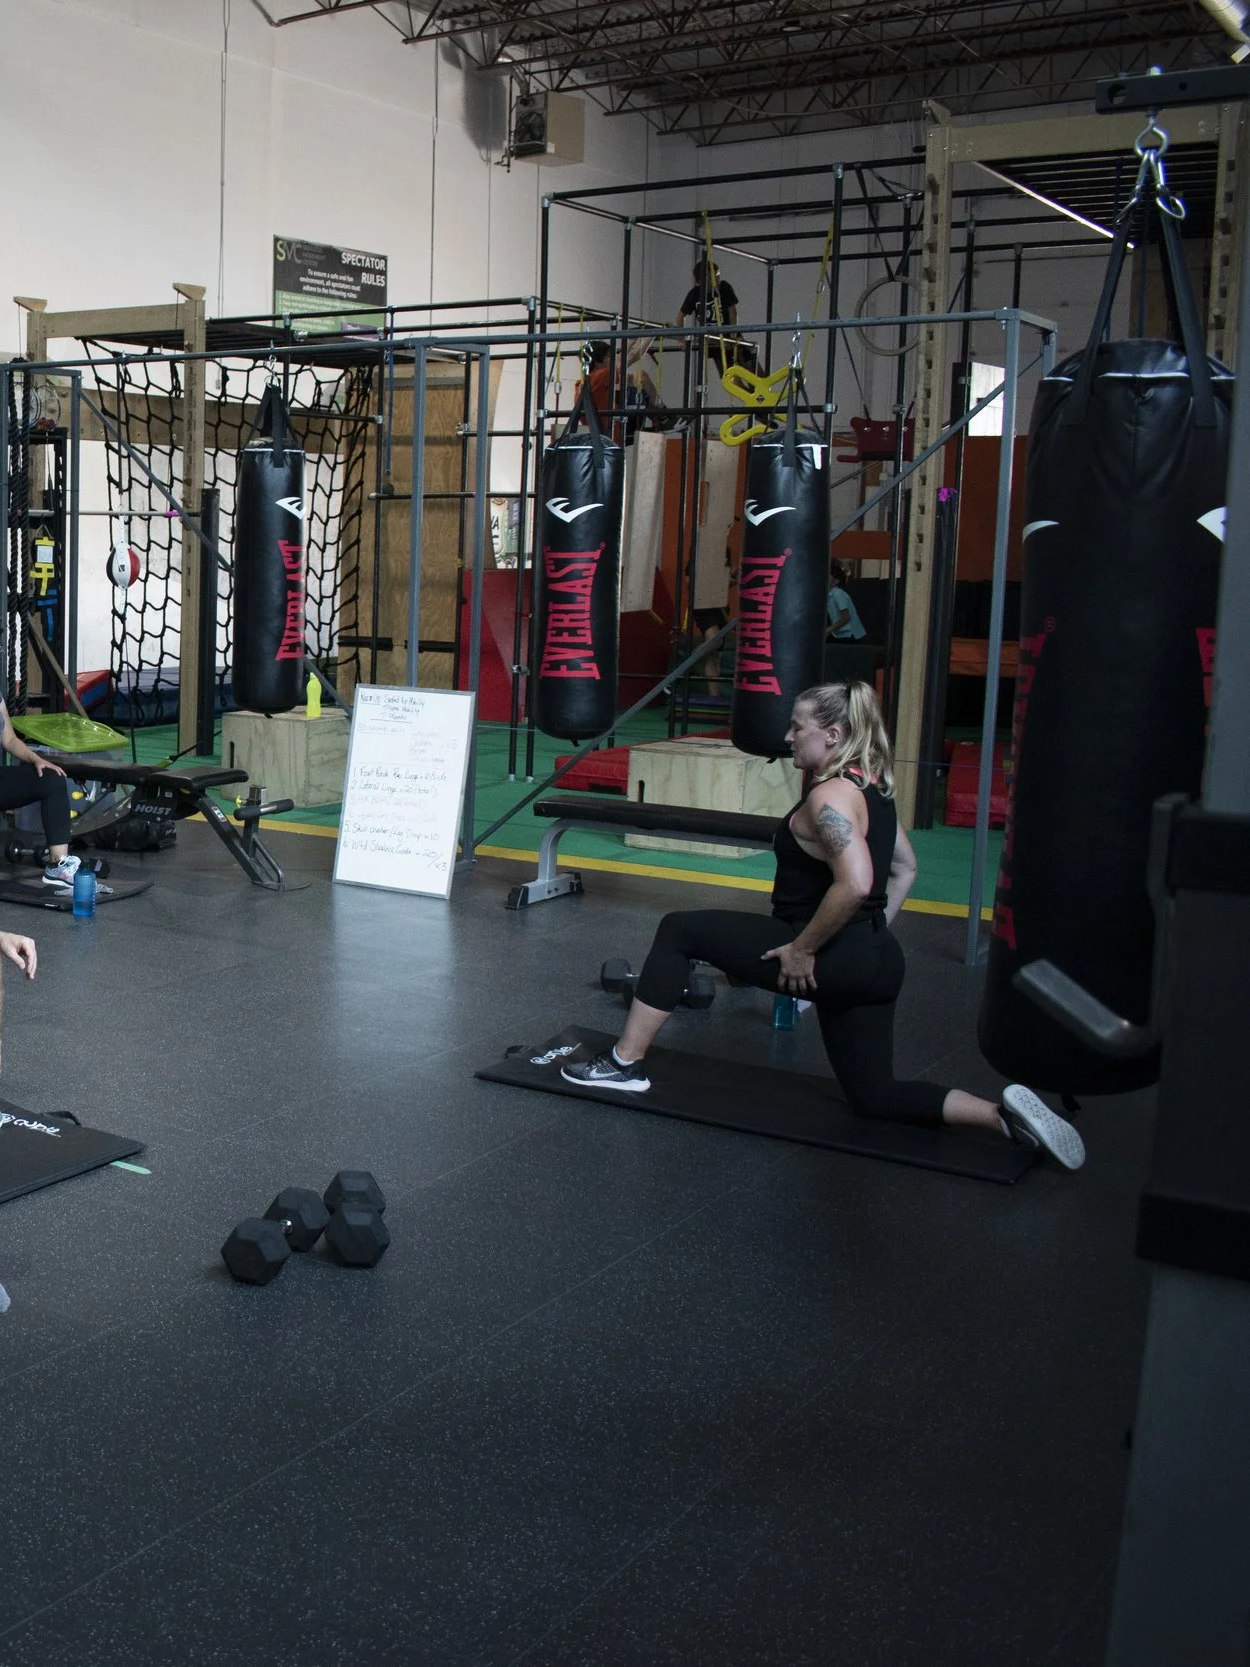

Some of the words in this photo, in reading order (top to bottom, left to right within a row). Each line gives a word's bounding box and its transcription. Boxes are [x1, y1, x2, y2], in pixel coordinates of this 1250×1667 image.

[341, 252, 386, 271] SPECTATOR
[361, 272, 386, 287] RULES
[538, 546, 602, 680] EVERLAST
[734, 555, 787, 696] EVERLAST
[134, 803, 172, 816] HOIST
